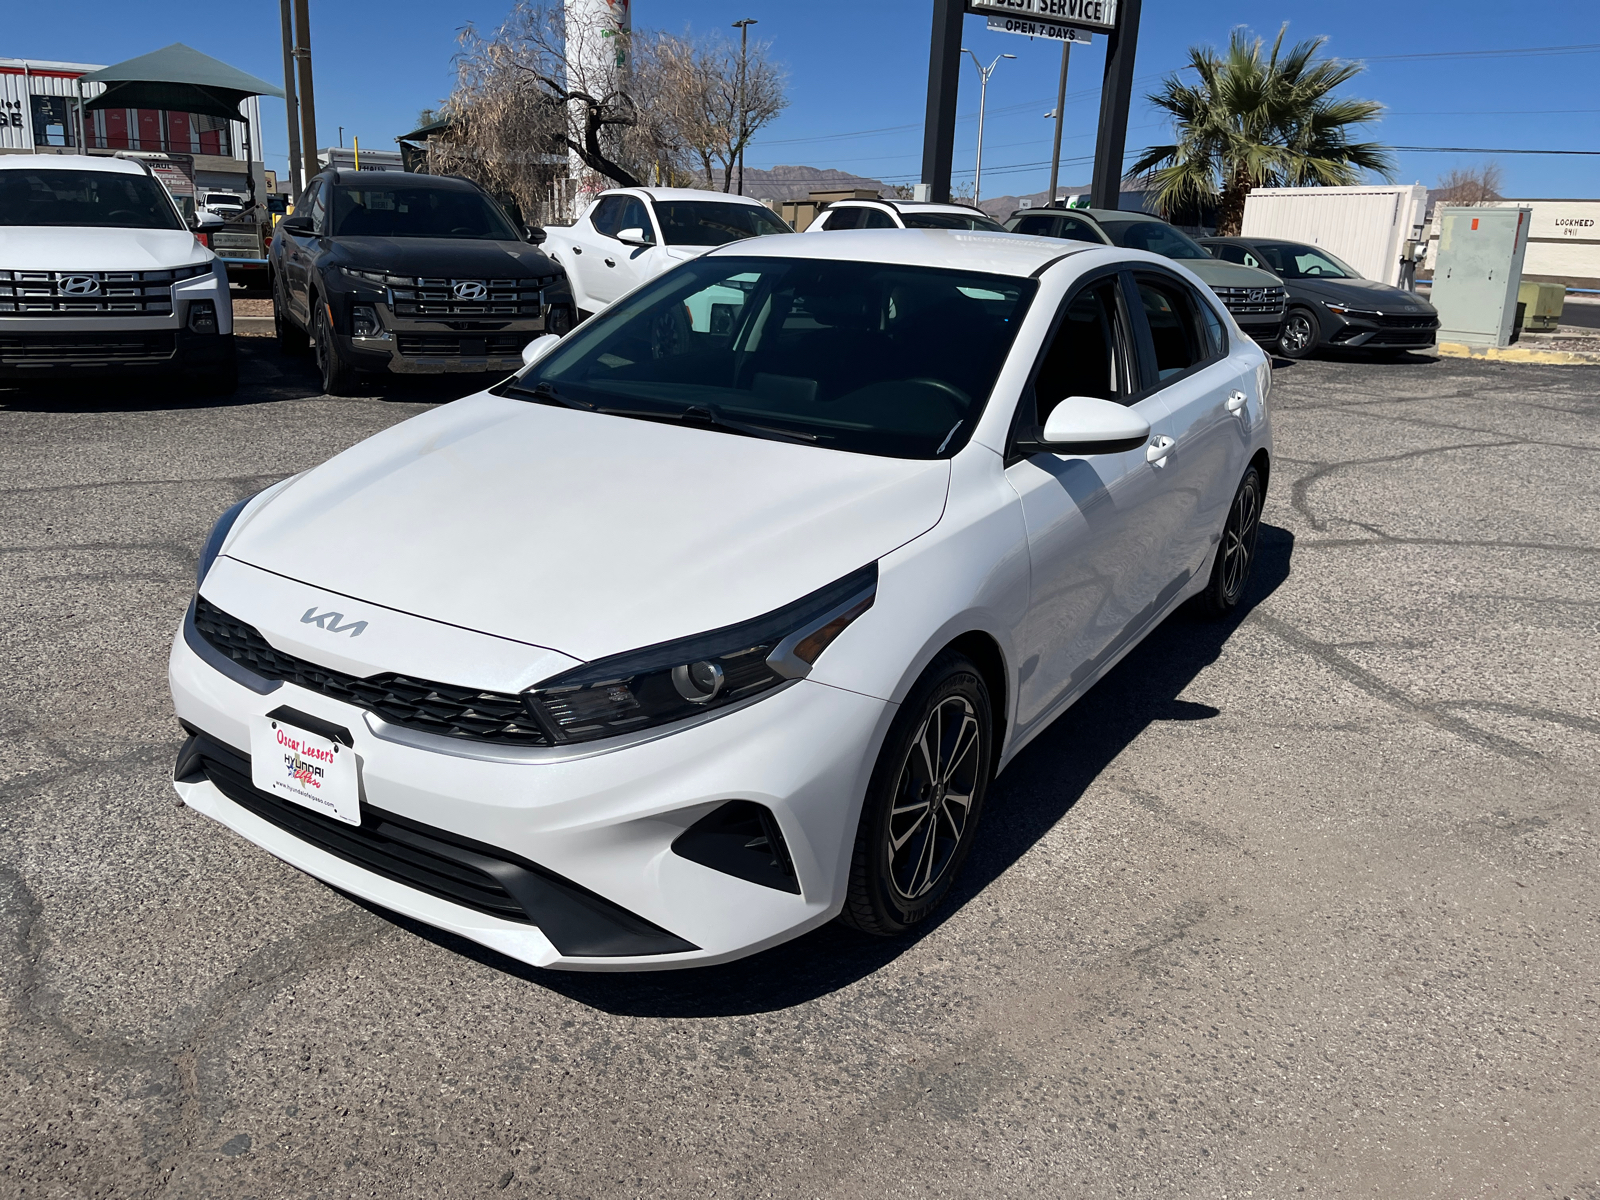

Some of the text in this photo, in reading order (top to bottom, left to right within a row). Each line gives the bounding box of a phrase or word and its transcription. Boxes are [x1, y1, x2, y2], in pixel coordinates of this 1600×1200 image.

[1040, 0, 1102, 20] SERVICE
[1005, 19, 1076, 41] OPEN 7 DAYS
[1555, 218, 1595, 227] LOCKHEED
[1563, 227, 1578, 236] 8411
[299, 606, 369, 638] KIA
[276, 729, 334, 764] Oscar Leeser's
[284, 753, 324, 778] HYUNDAI
